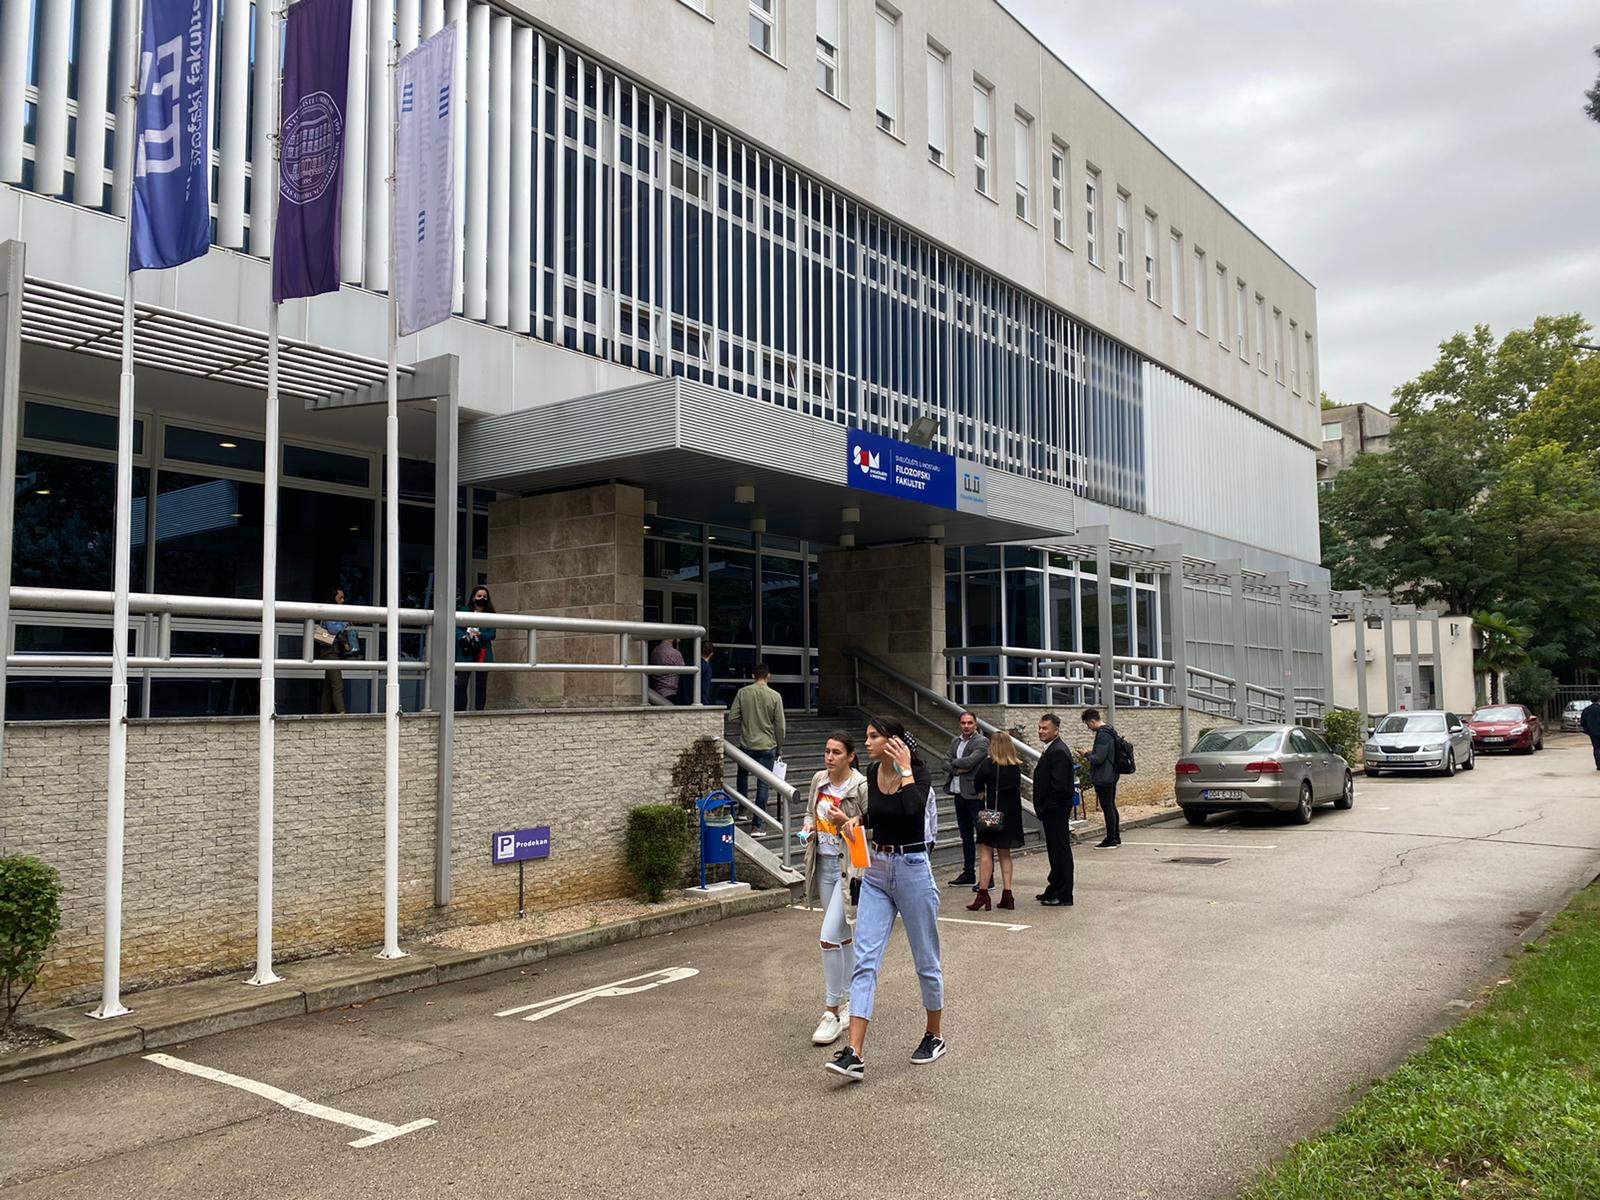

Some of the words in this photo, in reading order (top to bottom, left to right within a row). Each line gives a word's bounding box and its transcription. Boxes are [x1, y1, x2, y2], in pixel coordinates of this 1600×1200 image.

[895, 464, 931, 481] FILOZOFSKI
[895, 476, 925, 490] FAKULTET
[501, 837, 512, 852] P
